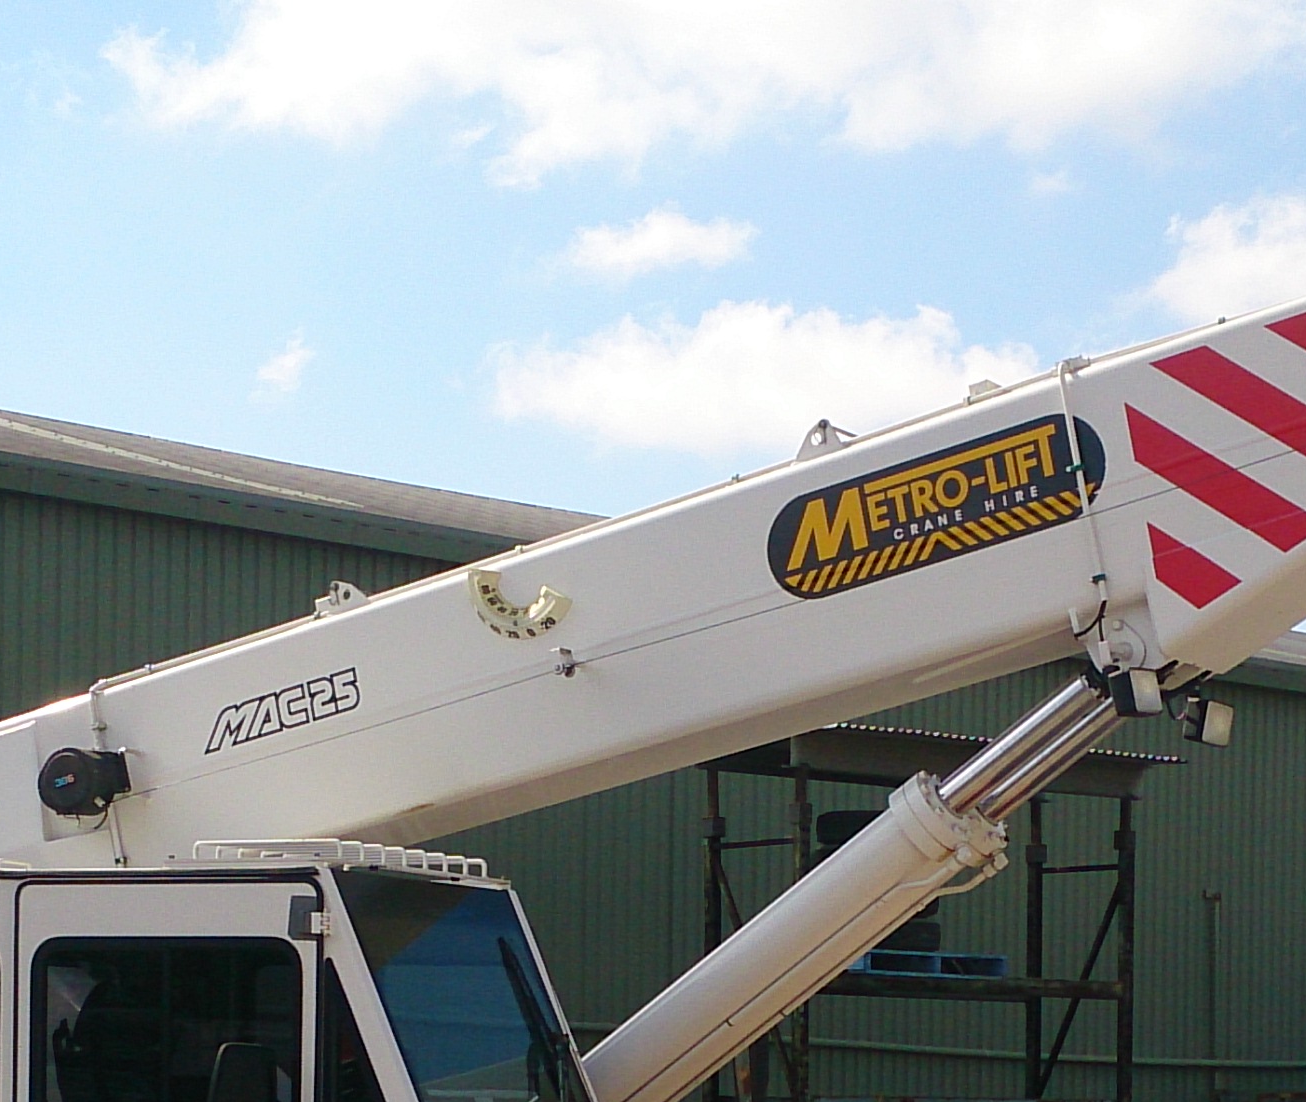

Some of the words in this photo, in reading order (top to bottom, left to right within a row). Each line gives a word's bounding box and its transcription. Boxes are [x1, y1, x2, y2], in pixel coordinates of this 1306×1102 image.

[786, 424, 1056, 572] METRO-LIFT
[894, 509, 963, 541] CRANE
[985, 485, 1040, 513] HIRE
[204, 667, 360, 755] MAC25
